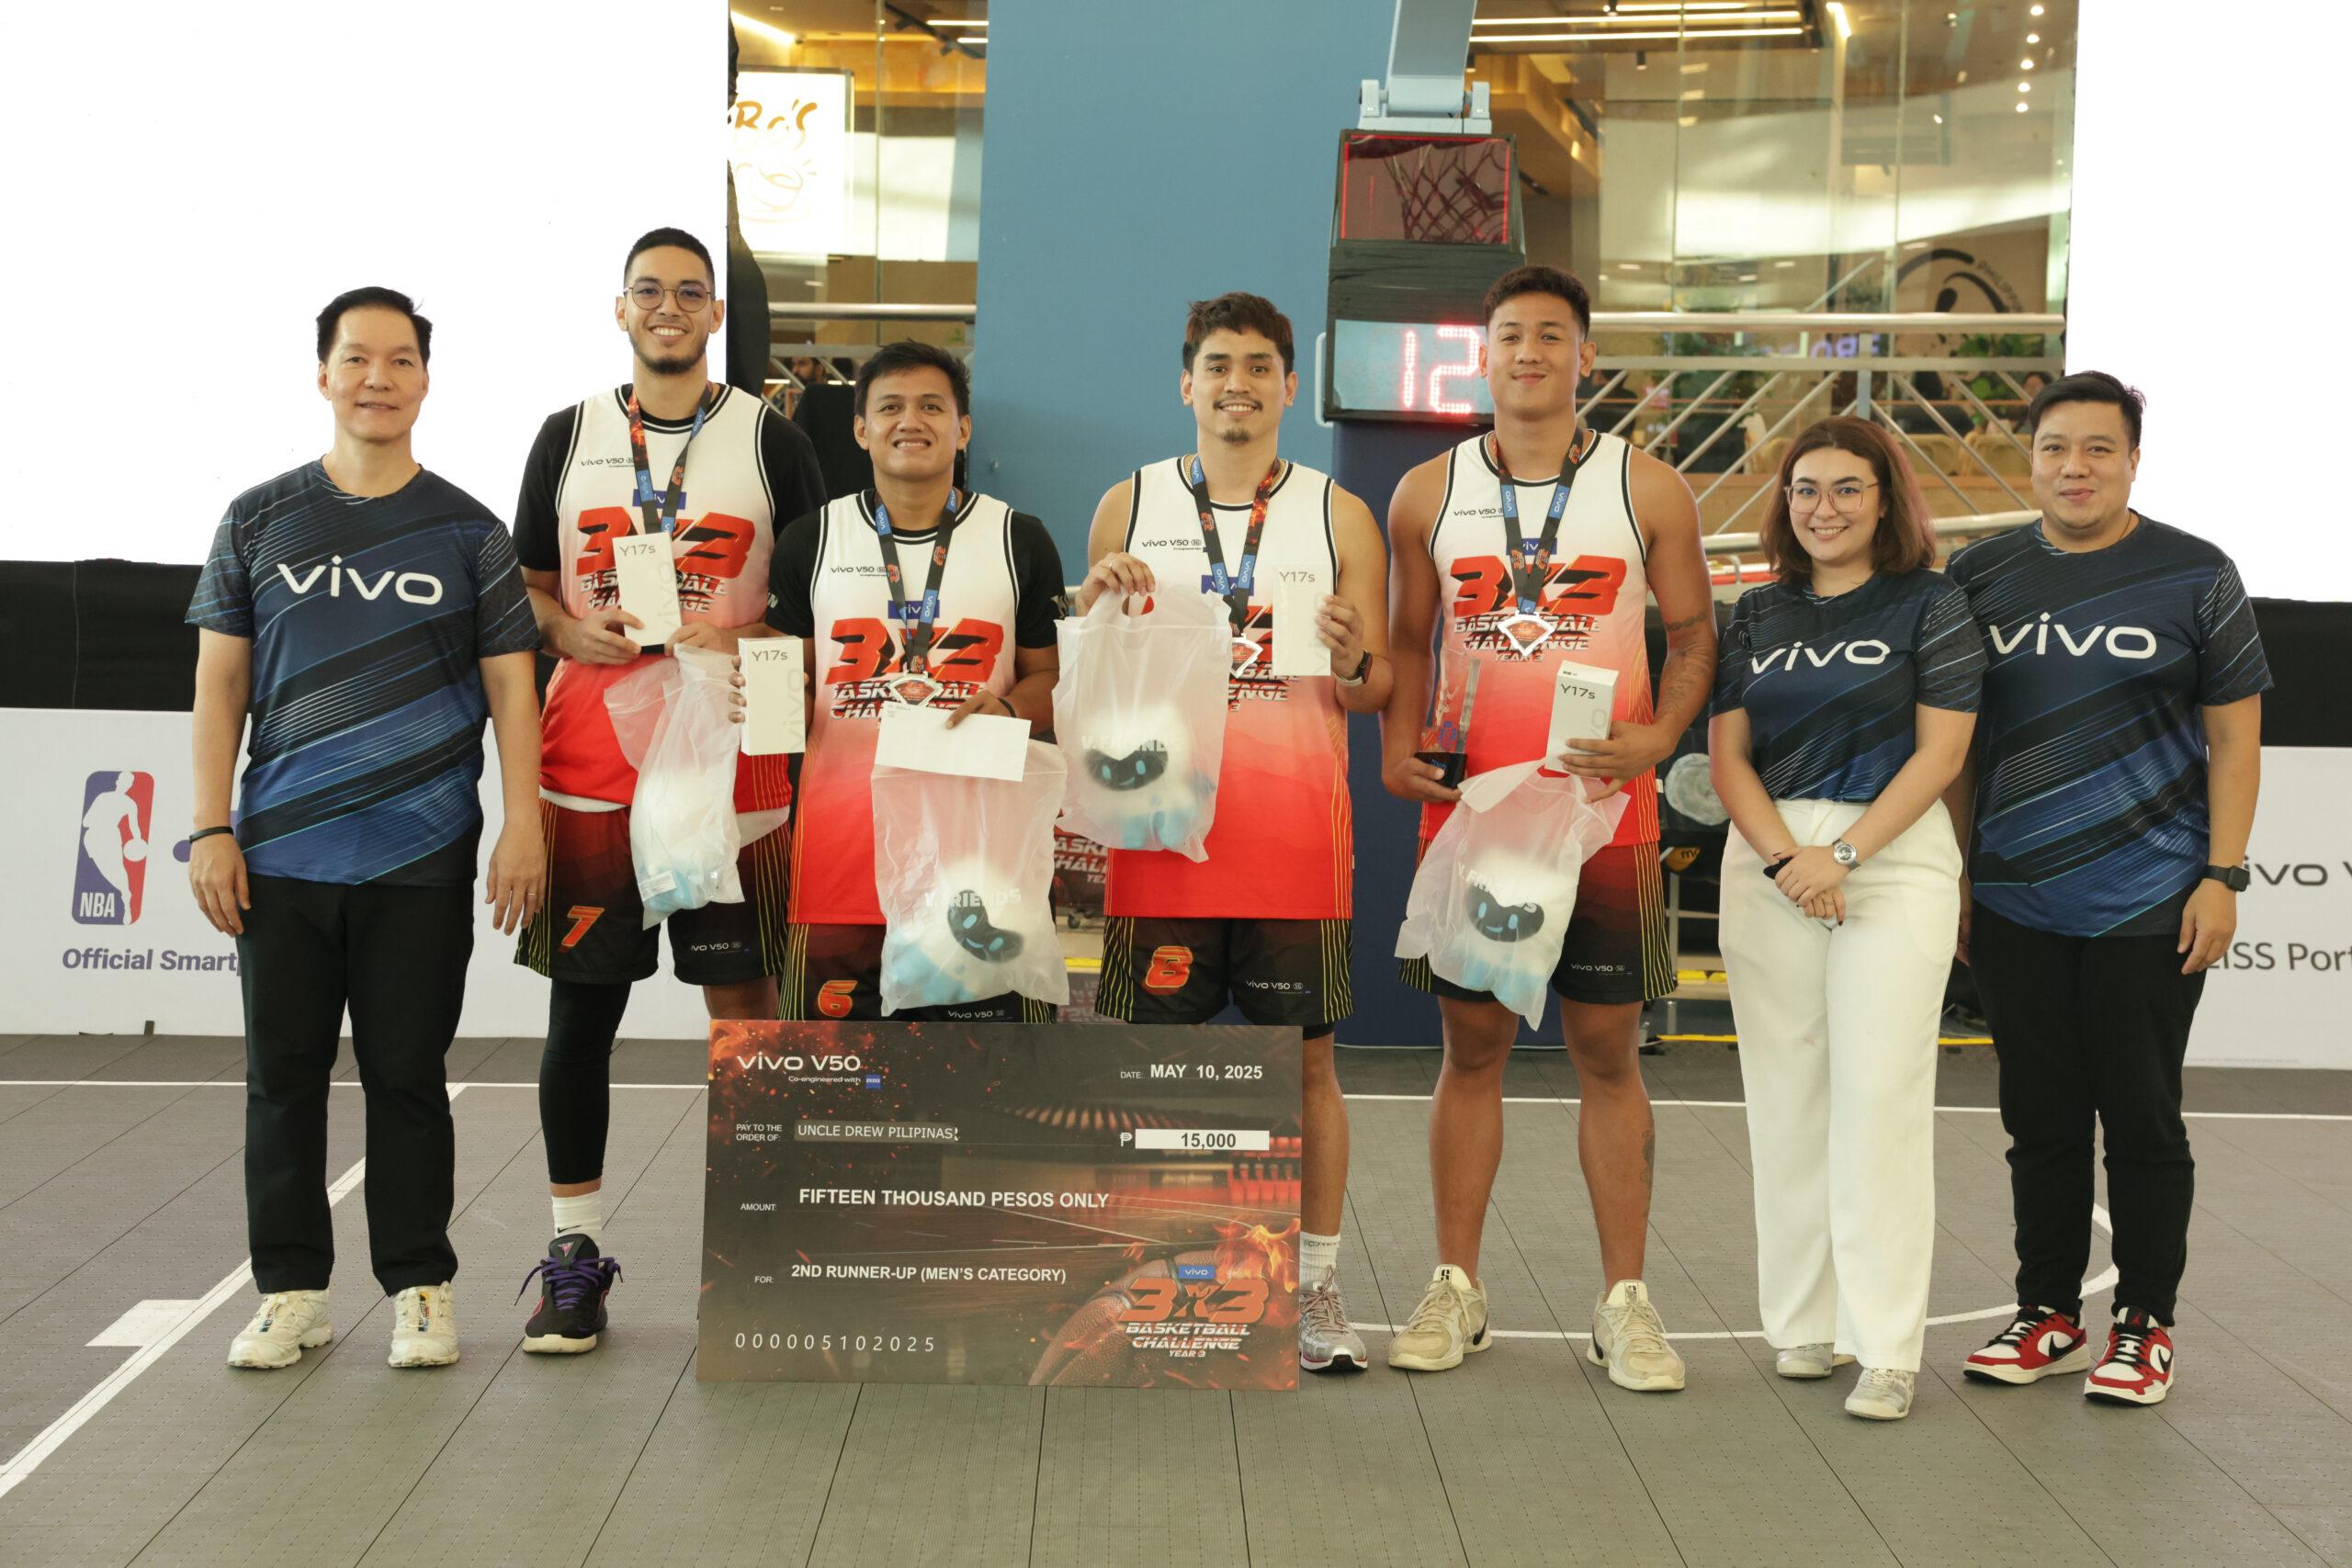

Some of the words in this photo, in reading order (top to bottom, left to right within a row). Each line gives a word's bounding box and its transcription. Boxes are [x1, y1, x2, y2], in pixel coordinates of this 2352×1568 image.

[1403, 325, 1480, 414] 12
[1554, 491, 1565, 513] vivo
[1142, 539, 1168, 547] vivo
[619, 544, 656, 557] Y17s
[831, 565, 854, 573] vivo
[1242, 560, 1251, 582] vivo
[277, 554, 443, 605] vivo
[1216, 569, 1226, 590] vivo
[1279, 571, 1316, 583] Y17s
[1988, 611, 2157, 660] vivo
[752, 650, 788, 661] Y17s
[1751, 639, 1891, 674] vivo
[1561, 683, 1596, 700] Y17s
[80, 892, 116, 918] NBA
[560, 905, 605, 947] 7
[62, 947, 153, 970] Official
[1570, 964, 1593, 972] vivo
[1246, 979, 1269, 989] vivo
[1271, 982, 1291, 990] V50
[817, 979, 858, 1018] 6
[947, 1009, 972, 1019] vivo
[736, 1051, 803, 1071] vivo
[810, 1055, 862, 1072] V50
[788, 1075, 842, 1084] Co-engineered
[843, 1075, 861, 1083] with
[1120, 1070, 1143, 1079] DATE:
[1150, 1065, 1187, 1078] MAY
[1196, 1065, 1219, 1081] 10,
[1225, 1066, 1262, 1079] 2025
[736, 1123, 752, 1132] PAY
[753, 1123, 764, 1132] TO
[766, 1124, 782, 1133] THE
[797, 1124, 841, 1137] UNCLE
[845, 1125, 884, 1137] DREW
[736, 1134, 765, 1142] ORDER
[767, 1134, 781, 1142] OF:
[1181, 1133, 1237, 1149] 15,000
[799, 1189, 876, 1205] FIFTEEN
[881, 1190, 985, 1207] THOUSAND
[991, 1192, 1055, 1207] PESOS
[1059, 1193, 1110, 1209] ONLY
[741, 1203, 777, 1212] AMOUNT:
[791, 1265, 822, 1278] 2ND
[826, 1266, 917, 1279] RUNNER-UP
[978, 1269, 1067, 1284] CATEGORY)
[1184, 1268, 1208, 1276] vivo
[754, 1276, 774, 1284] FOR:
[1125, 1323, 1251, 1336] BASKETBALL
[1132, 1337, 1243, 1350] CHALLENGE
